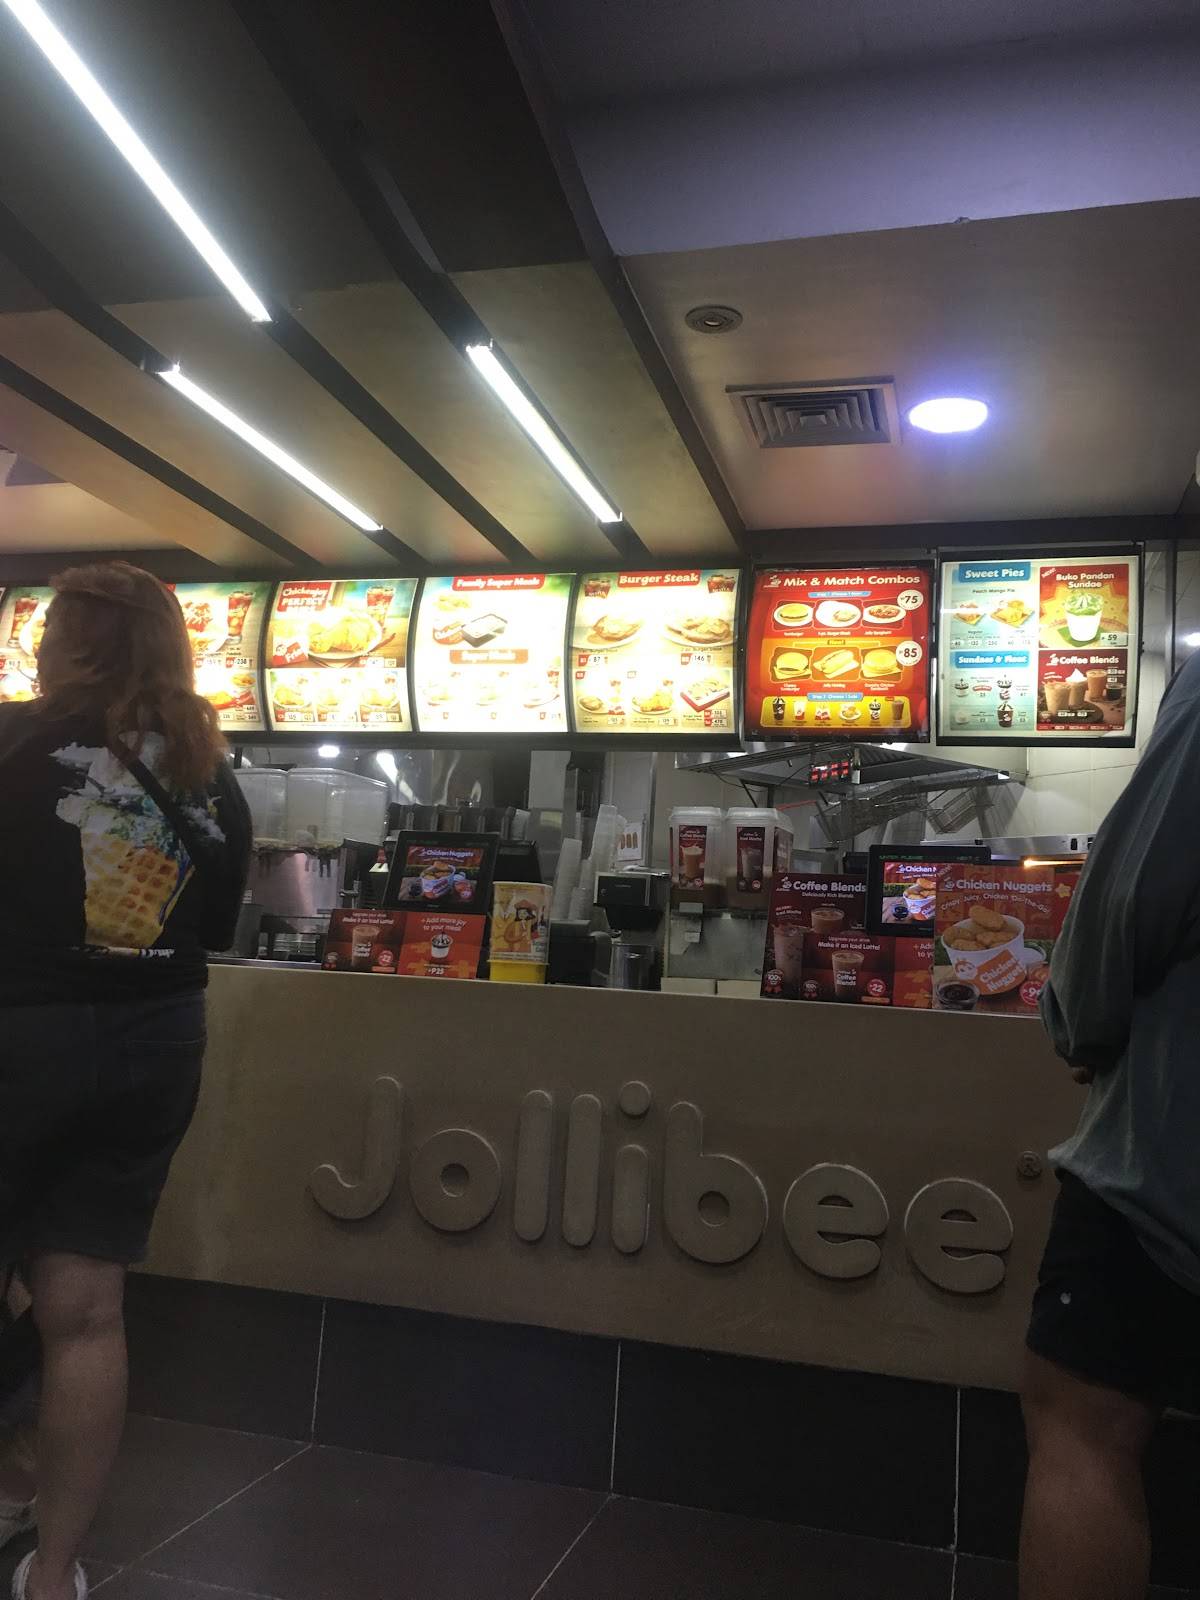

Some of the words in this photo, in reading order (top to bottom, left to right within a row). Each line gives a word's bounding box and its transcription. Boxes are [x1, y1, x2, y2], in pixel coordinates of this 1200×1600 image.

[965, 570, 999, 578] Sweet
[1002, 568, 1025, 578] Pies
[1056, 573, 1078, 581] Buko
[1080, 572, 1115, 580] Pandan
[619, 575, 662, 585] Burger
[663, 573, 699, 583] Steak
[784, 577, 807, 587] Mix
[810, 577, 820, 585] &
[824, 575, 865, 586] Match
[868, 574, 921, 585] Combos
[1067, 581, 1102, 589] Sundae
[958, 656, 994, 664] Sundaes
[1059, 656, 1088, 664] Coffee
[1089, 655, 1119, 664] Blends
[450, 850, 474, 859] Nuggets
[793, 881, 829, 892] Coffee
[830, 882, 866, 892] Blends
[956, 879, 1000, 890] Chicken
[1003, 881, 1052, 893] Nuggets
[426, 917, 440, 925] Add
[440, 917, 456, 925] more
[456, 919, 466, 928] joy
[432, 925, 445, 933] your
[980, 957, 1017, 982] Chicken
[307, 1075, 1014, 1294] Jollibee
